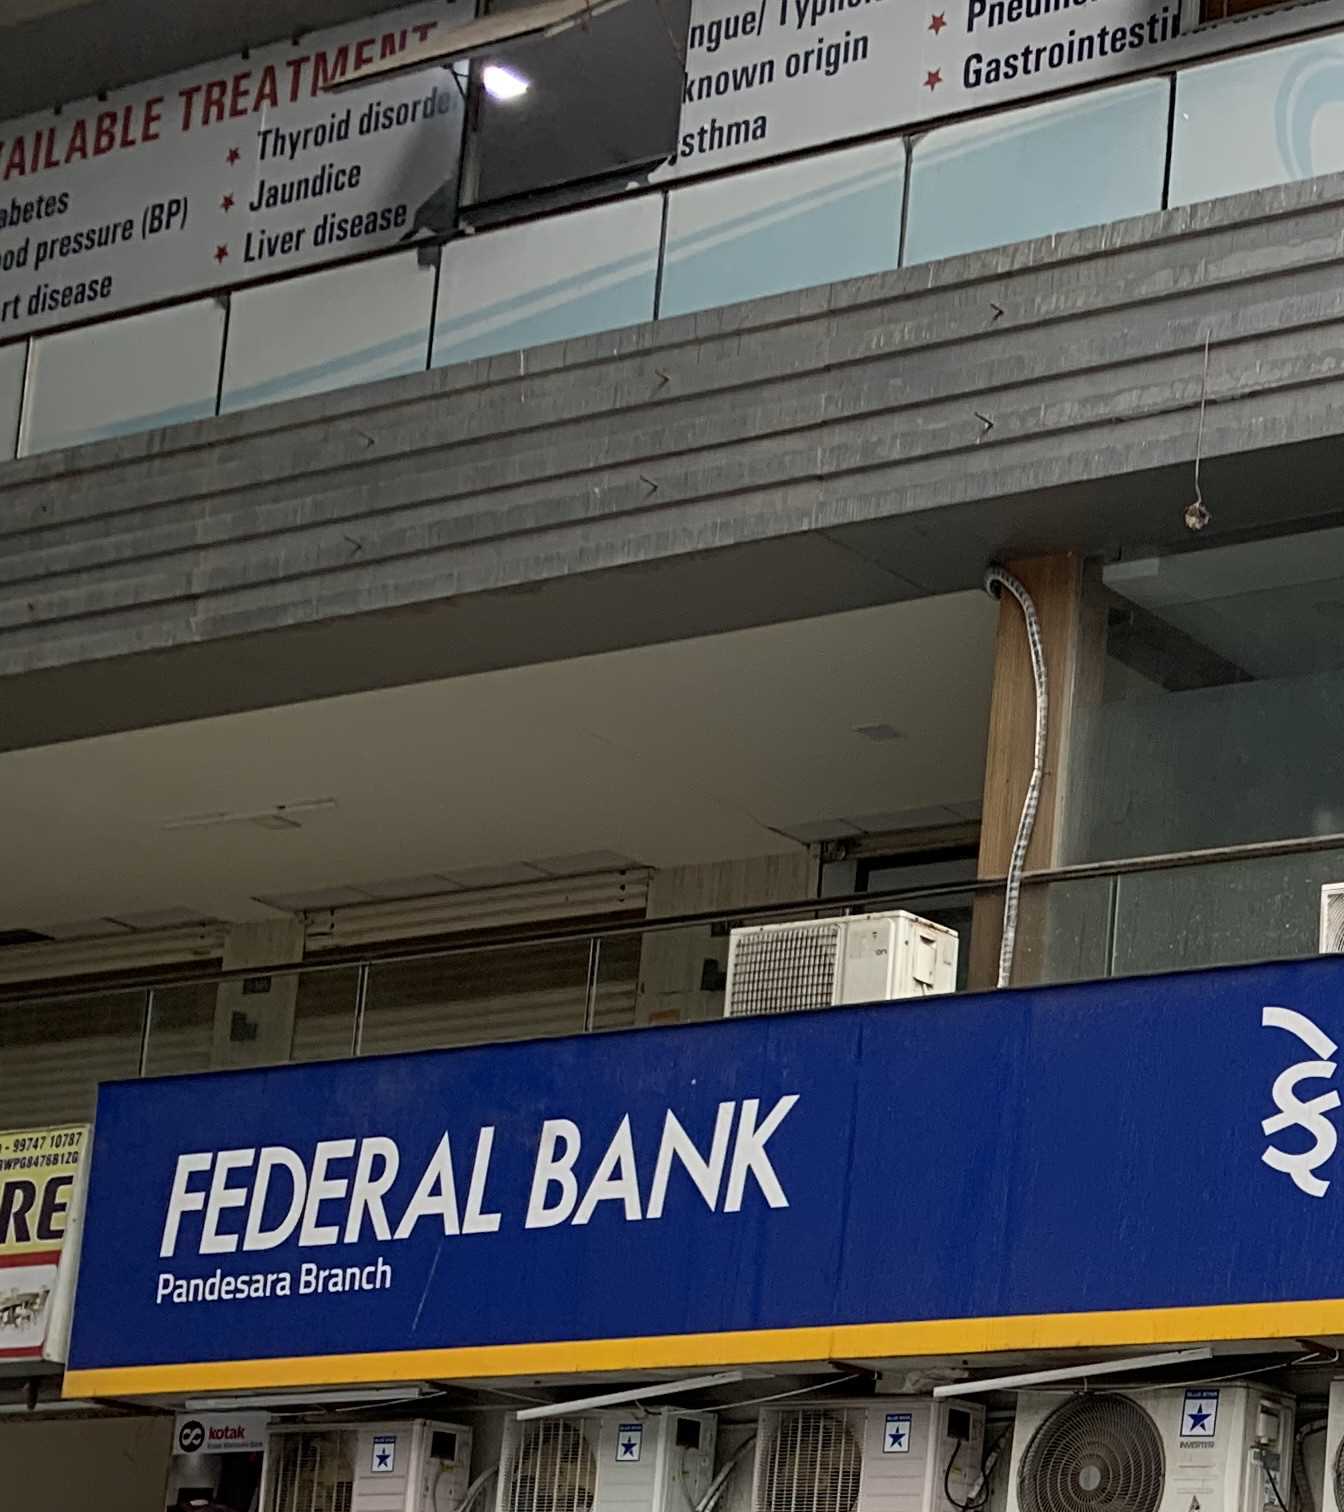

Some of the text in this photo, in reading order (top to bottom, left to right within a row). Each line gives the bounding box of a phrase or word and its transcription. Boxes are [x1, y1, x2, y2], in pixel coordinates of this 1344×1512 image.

[683, 32, 868, 105] known origin
[0, 97, 163, 181] AILABLE
[256, 109, 350, 163] Thyroid
[672, 114, 768, 163] sthma
[249, 162, 361, 212] Jaundice
[34, 196, 189, 272] pressure (BP)
[243, 203, 408, 263] Liver disease
[27, 274, 113, 318] disease
[13, 1132, 83, 1152] 99747 10787
[158, 1094, 801, 1259] FEDERAL BANK
[0, 1175, 73, 1245] RE
[155, 1256, 392, 1305] Pandesara Branch
[208, 1426, 246, 1440] kotak
